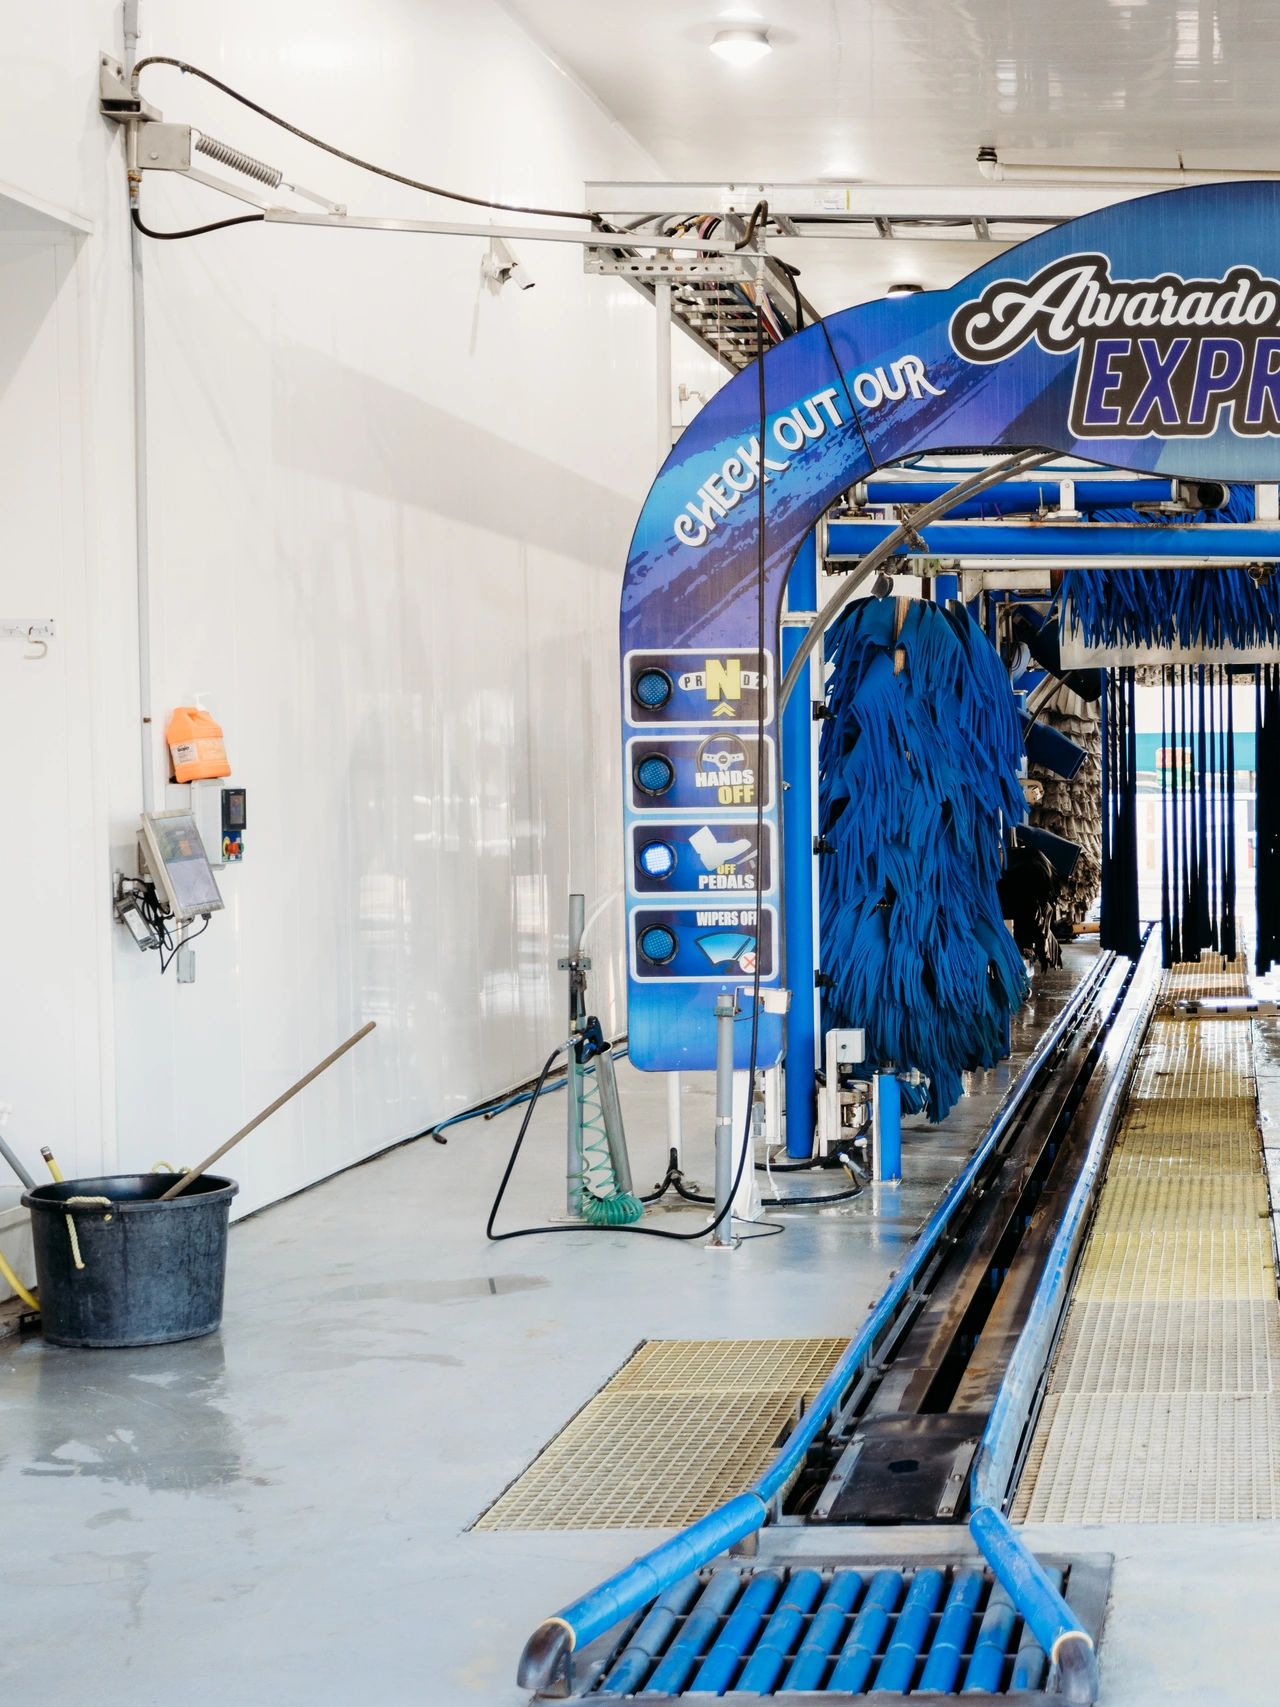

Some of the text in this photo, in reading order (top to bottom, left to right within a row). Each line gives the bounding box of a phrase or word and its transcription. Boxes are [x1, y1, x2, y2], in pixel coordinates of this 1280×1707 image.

[965, 264, 1278, 351] Alvarado
[673, 355, 946, 547] CHECK OUT OUR
[705, 659, 740, 700] N
[695, 769, 755, 788] HANDS
[718, 784, 754, 804] OFF
[698, 874, 755, 890] PEDALS
[696, 911, 739, 927] WIPERS
